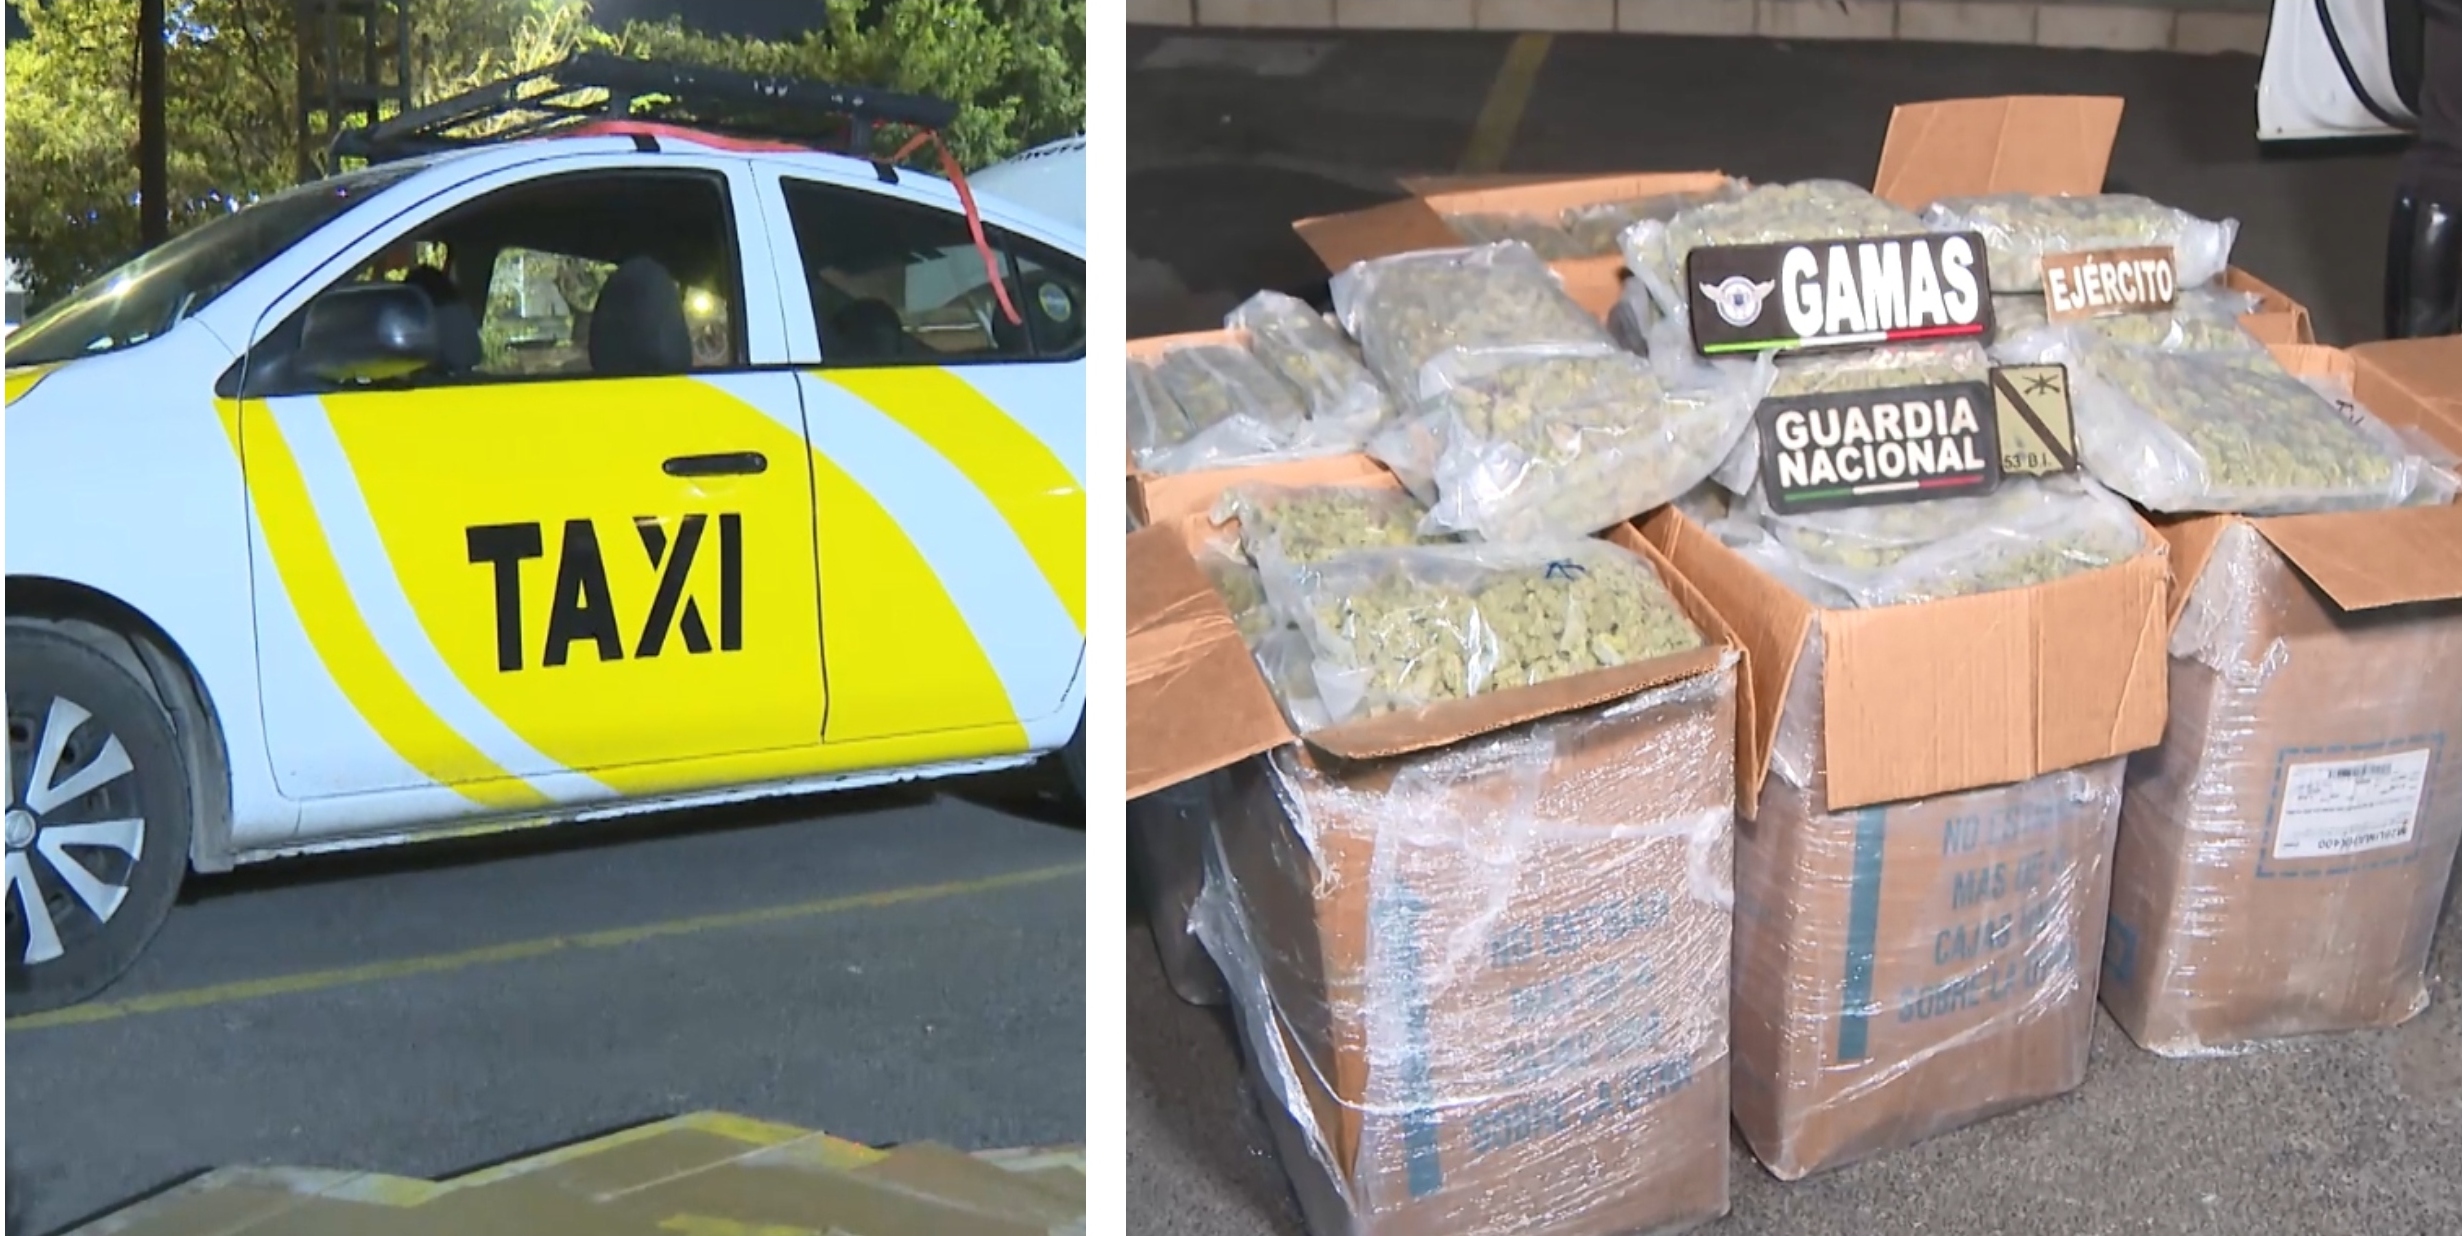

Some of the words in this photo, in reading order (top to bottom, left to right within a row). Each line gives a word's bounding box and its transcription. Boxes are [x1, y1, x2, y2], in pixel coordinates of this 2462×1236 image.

[1781, 236, 1979, 337] GAMAS
[2048, 254, 2173, 312] EJÉRCITO
[1775, 397, 1979, 449] GUARDIA
[1777, 435, 1986, 488] NACIONAL
[2004, 454, 2021, 469] 53
[465, 513, 742, 673] TAXI
[1943, 814, 1979, 855] NO
[1953, 862, 2006, 909] MAS
[1935, 914, 2012, 966] CAJAS
